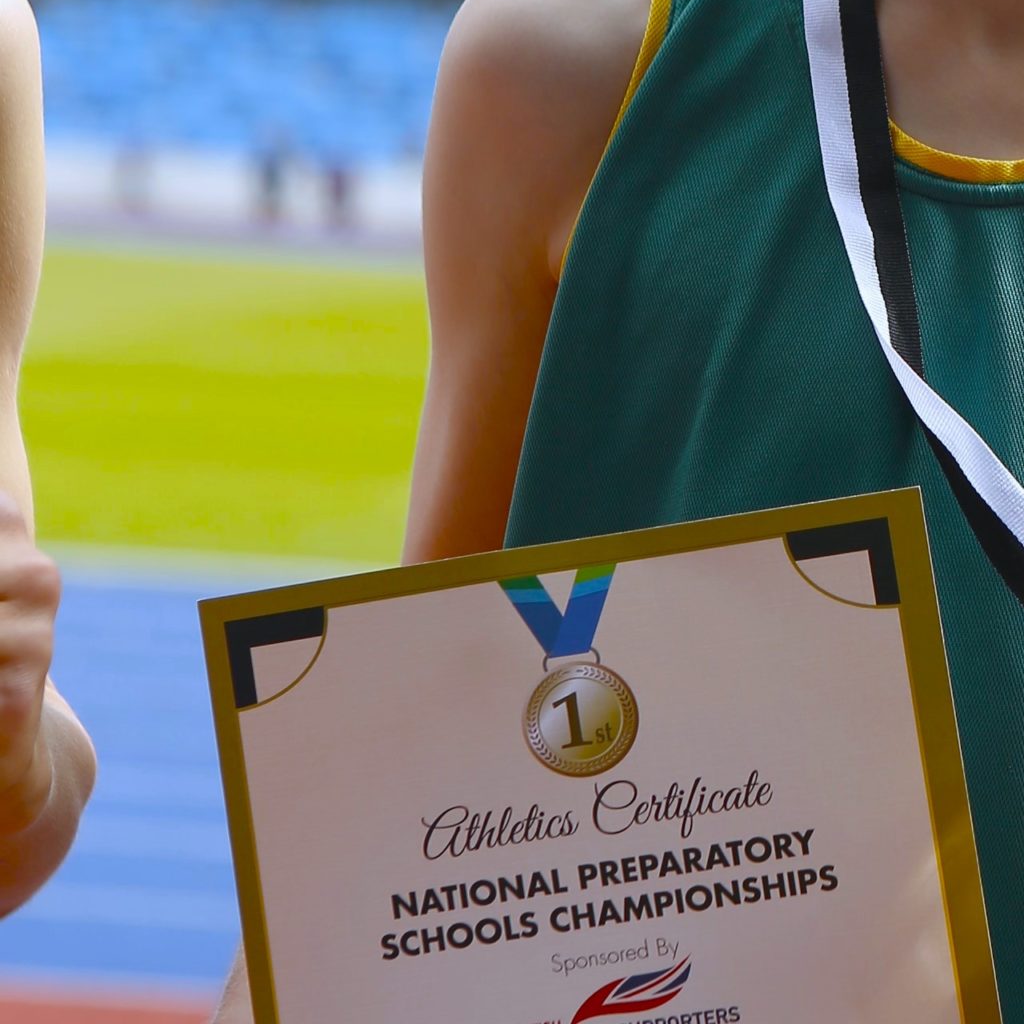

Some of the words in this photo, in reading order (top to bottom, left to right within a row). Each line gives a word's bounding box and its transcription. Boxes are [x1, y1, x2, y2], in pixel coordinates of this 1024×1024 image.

[552, 691, 612, 749] 1st
[421, 804, 579, 860] Athletics
[592, 769, 773, 839] Certificate
[381, 911, 539, 960] SCHOOLS
[550, 865, 838, 933] CHAMPIONSHIPS
[391, 869, 568, 920] NATIONAL
[578, 829, 815, 890] PREPARATORY
[551, 939, 649, 976] Sponsored
[656, 937, 679, 960] By
